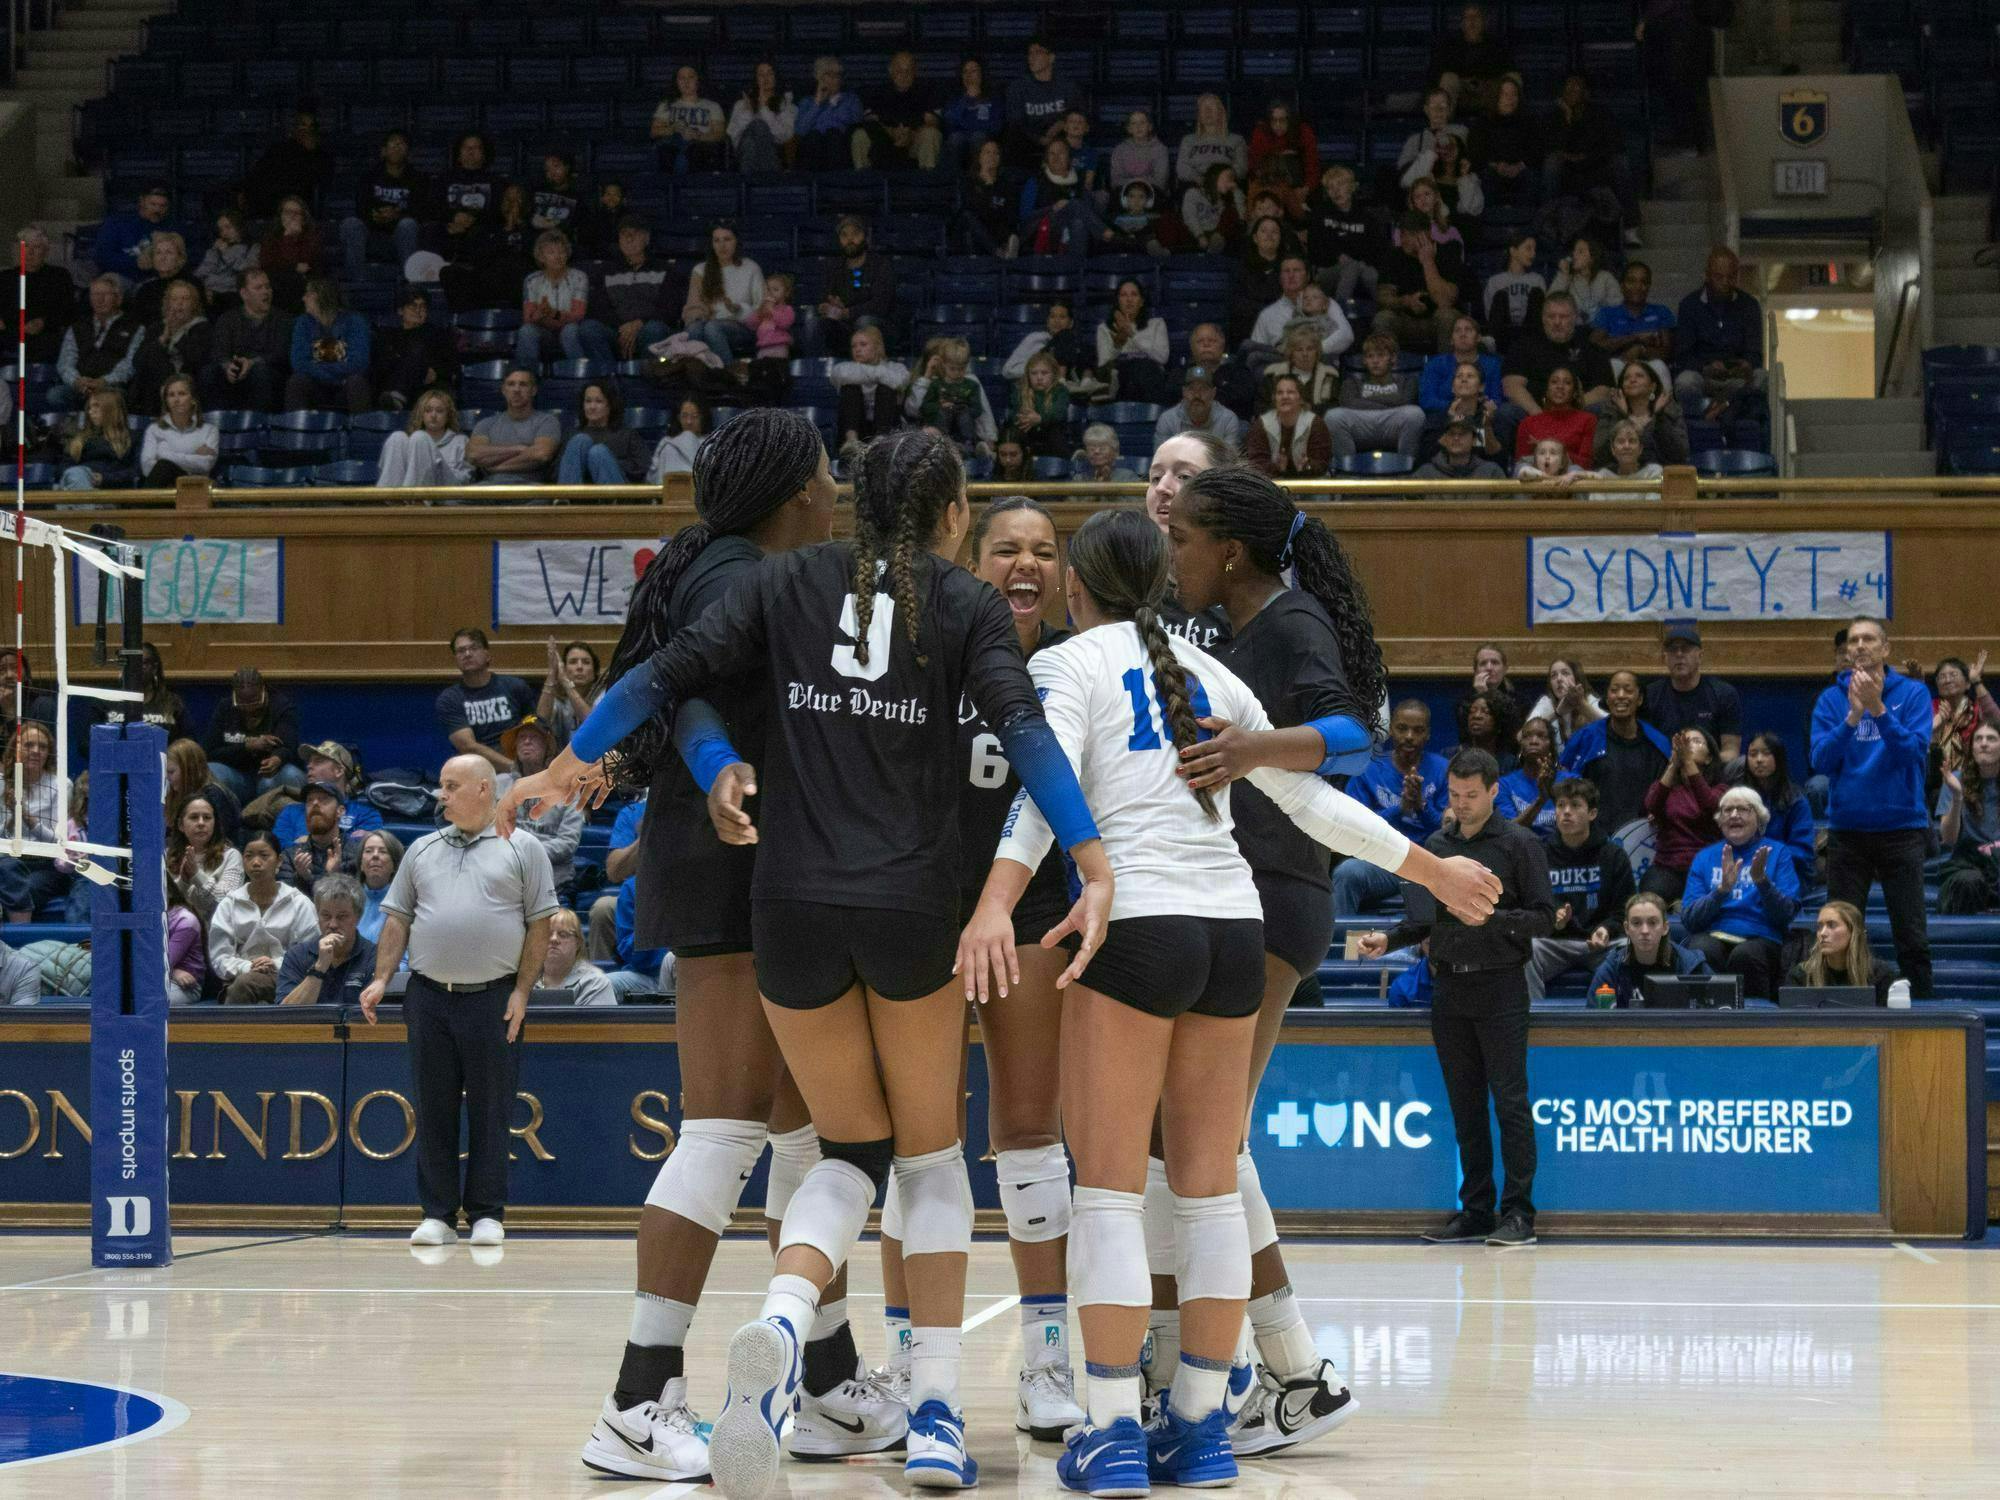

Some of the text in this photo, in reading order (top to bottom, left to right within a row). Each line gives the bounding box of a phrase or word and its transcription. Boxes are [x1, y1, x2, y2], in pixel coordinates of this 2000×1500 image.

[1026, 101, 1066, 117] DUKE
[1793, 107, 1815, 136] 6
[1785, 165, 1826, 193] EXIT
[107, 542, 247, 619] GOZI
[537, 546, 623, 618] WE
[1838, 572, 1887, 603] #4
[831, 592, 895, 682] 9
[1156, 616, 1221, 649] uke
[464, 697, 512, 725] DUKE
[788, 682, 842, 716] Blue
[850, 687, 928, 725] Devils
[969, 733, 1010, 789] 6
[1549, 867, 1600, 886] DUKE
[1711, 866, 1766, 886] DK
[118, 1048, 136, 1181] sports imports
[172, 1089, 557, 1162] INDOR
[1354, 1101, 1433, 1149] NC
[1583, 1098, 1672, 1127] MOST
[1679, 1099, 1853, 1128] PREFERRED
[1556, 1126, 1813, 1155] HEALTH INSURER
[104, 1253, 153, 1262] (800) 556-3198
